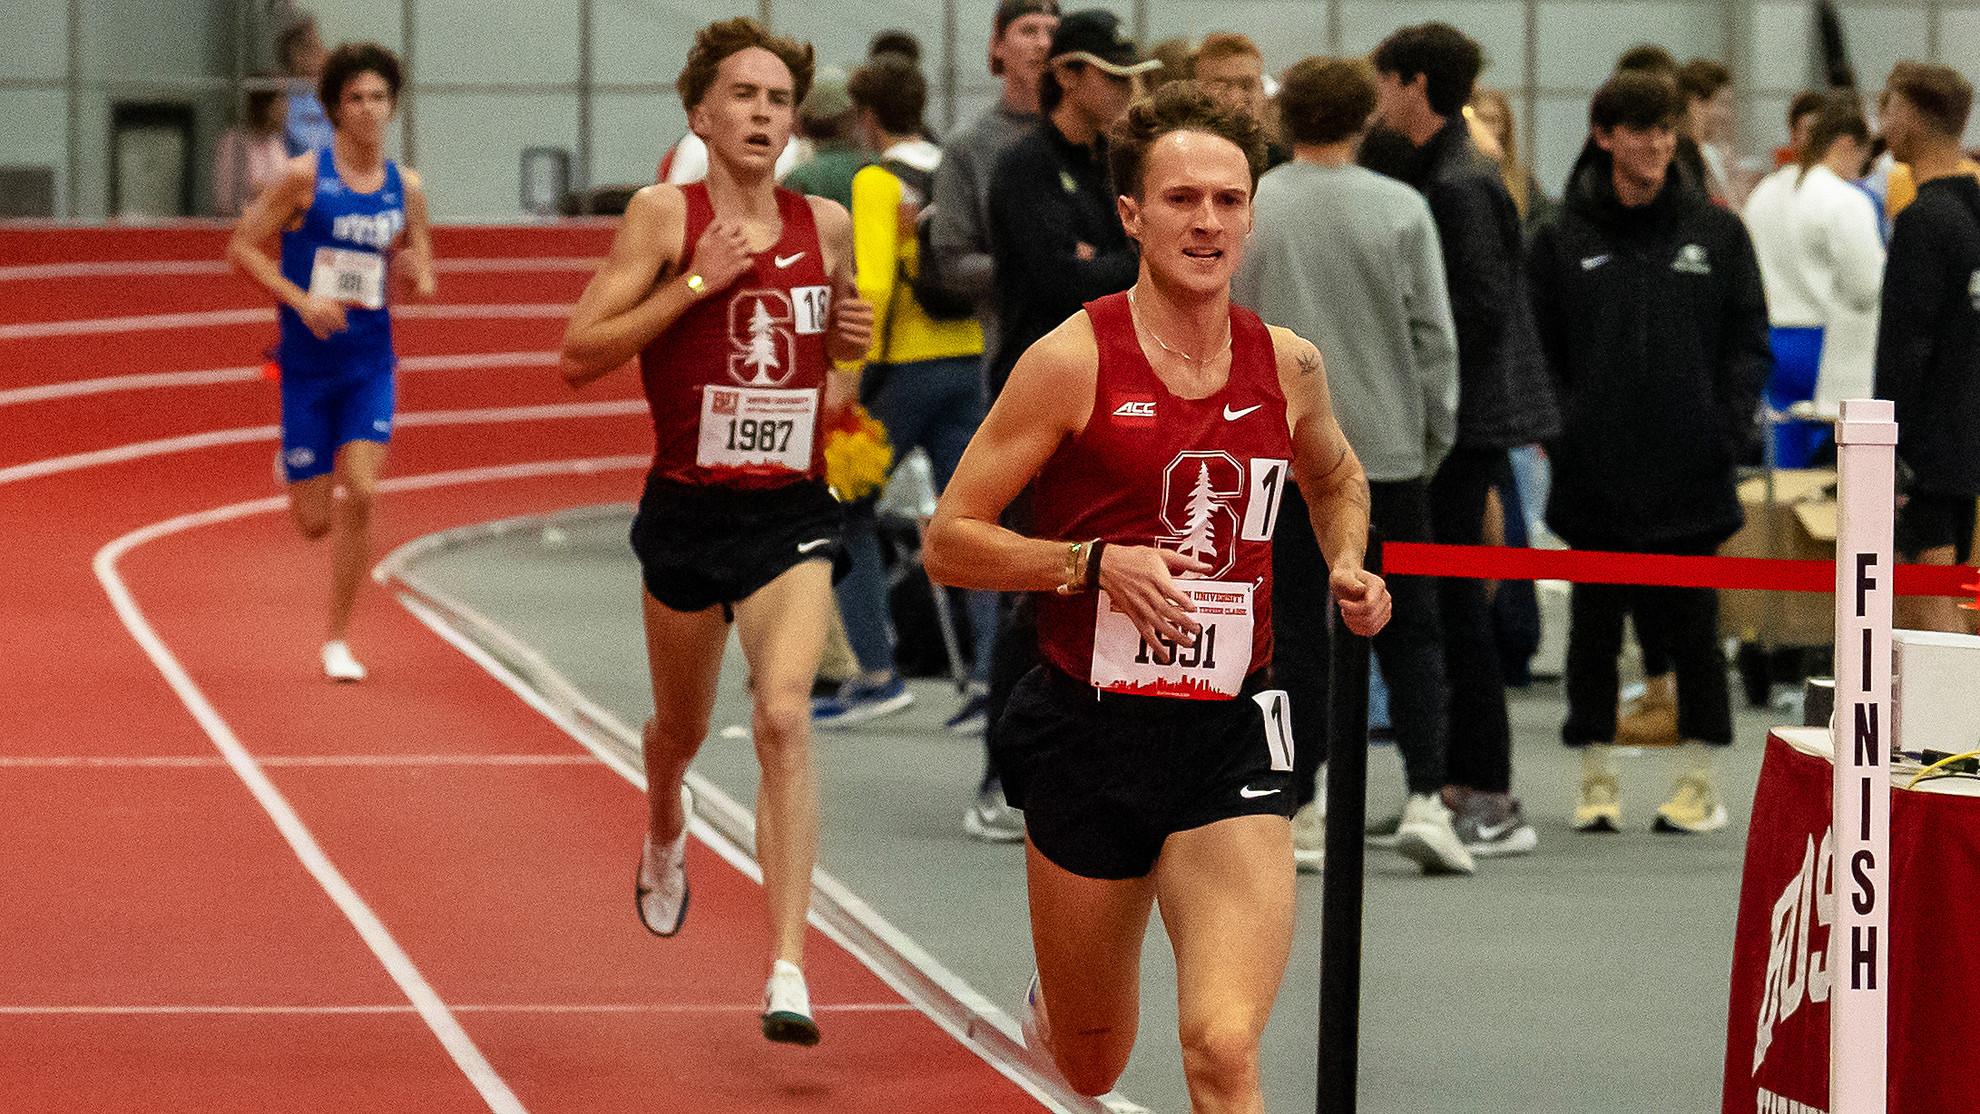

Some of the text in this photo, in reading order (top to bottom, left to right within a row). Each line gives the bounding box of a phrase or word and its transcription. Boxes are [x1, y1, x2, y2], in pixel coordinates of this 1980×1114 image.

[726, 418, 793, 452] 1987
[1112, 401, 1157, 416] ACC
[1262, 465, 1281, 537] 1
[1271, 695, 1291, 767] 1
[1850, 552, 1879, 990] FINISH
